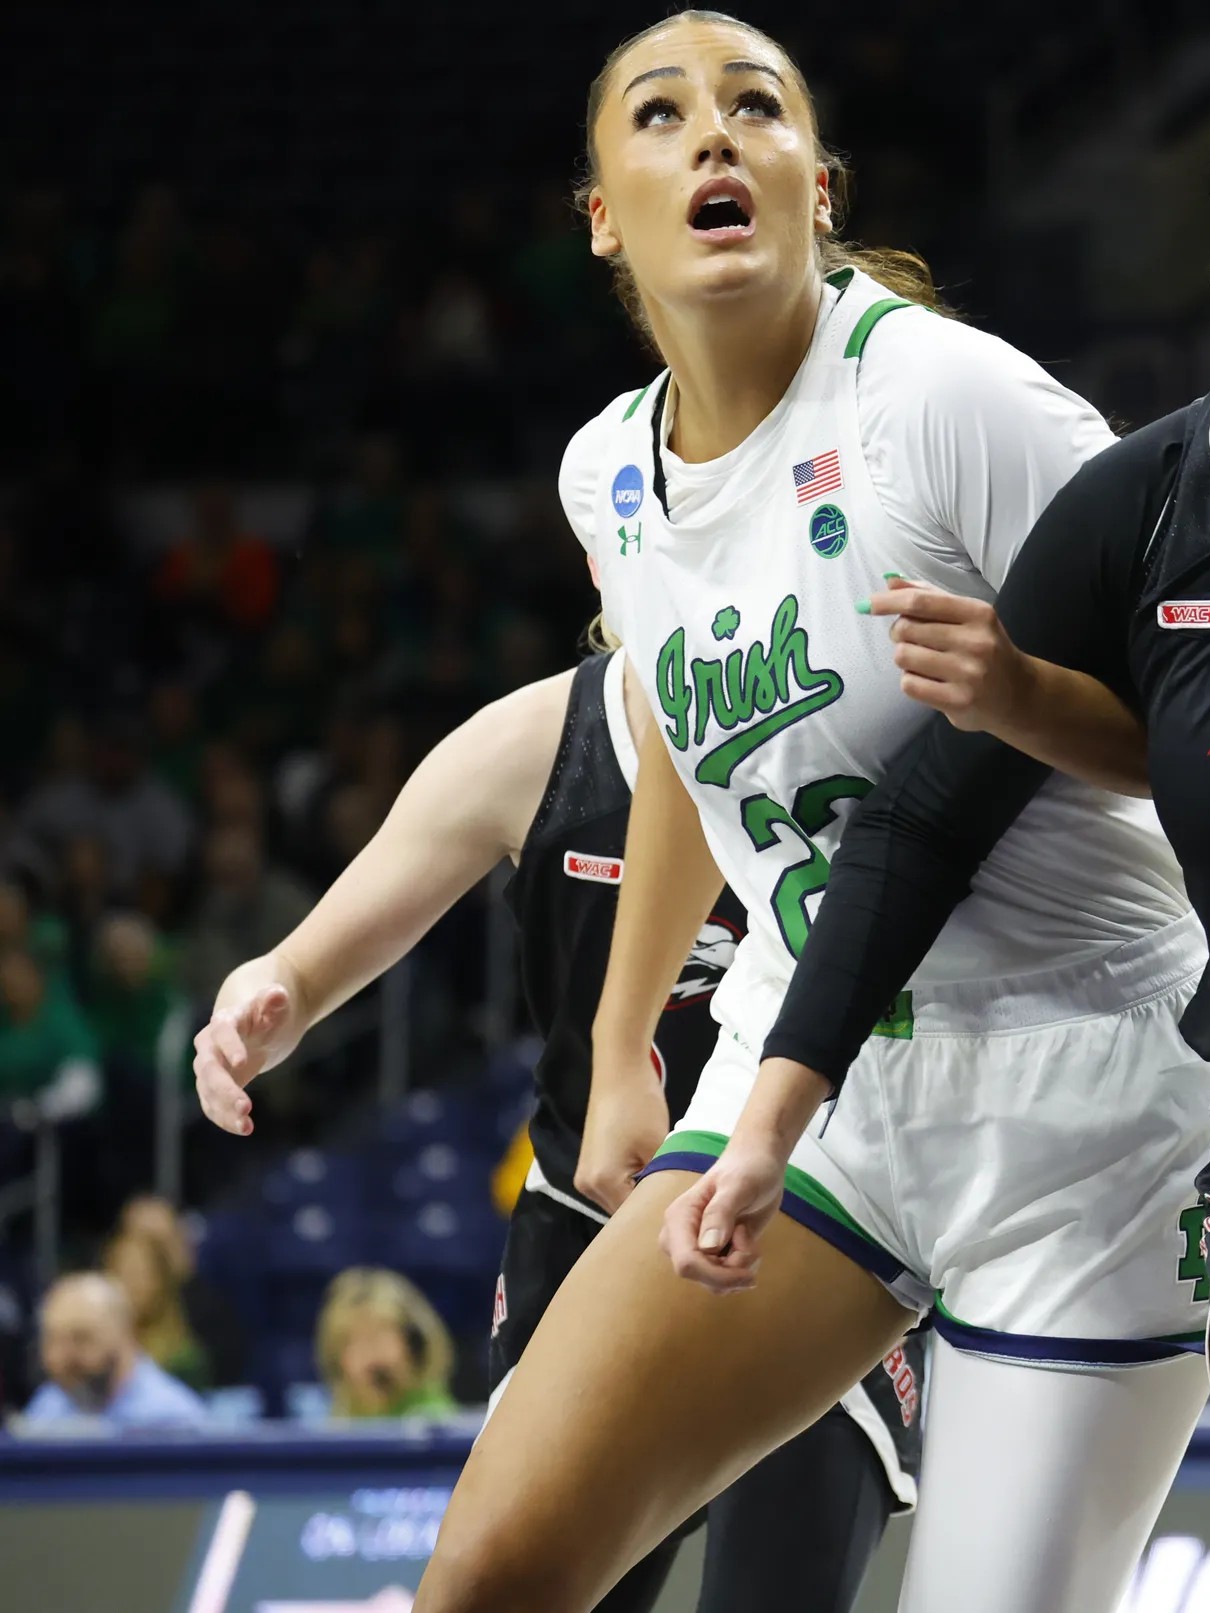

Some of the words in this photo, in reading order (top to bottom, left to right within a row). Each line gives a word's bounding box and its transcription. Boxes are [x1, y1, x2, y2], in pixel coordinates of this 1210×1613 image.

[815, 516, 845, 540] ACC
[1170, 606, 1210, 622] WAC
[656, 593, 845, 752] Irish
[575, 859, 613, 878] WAC
